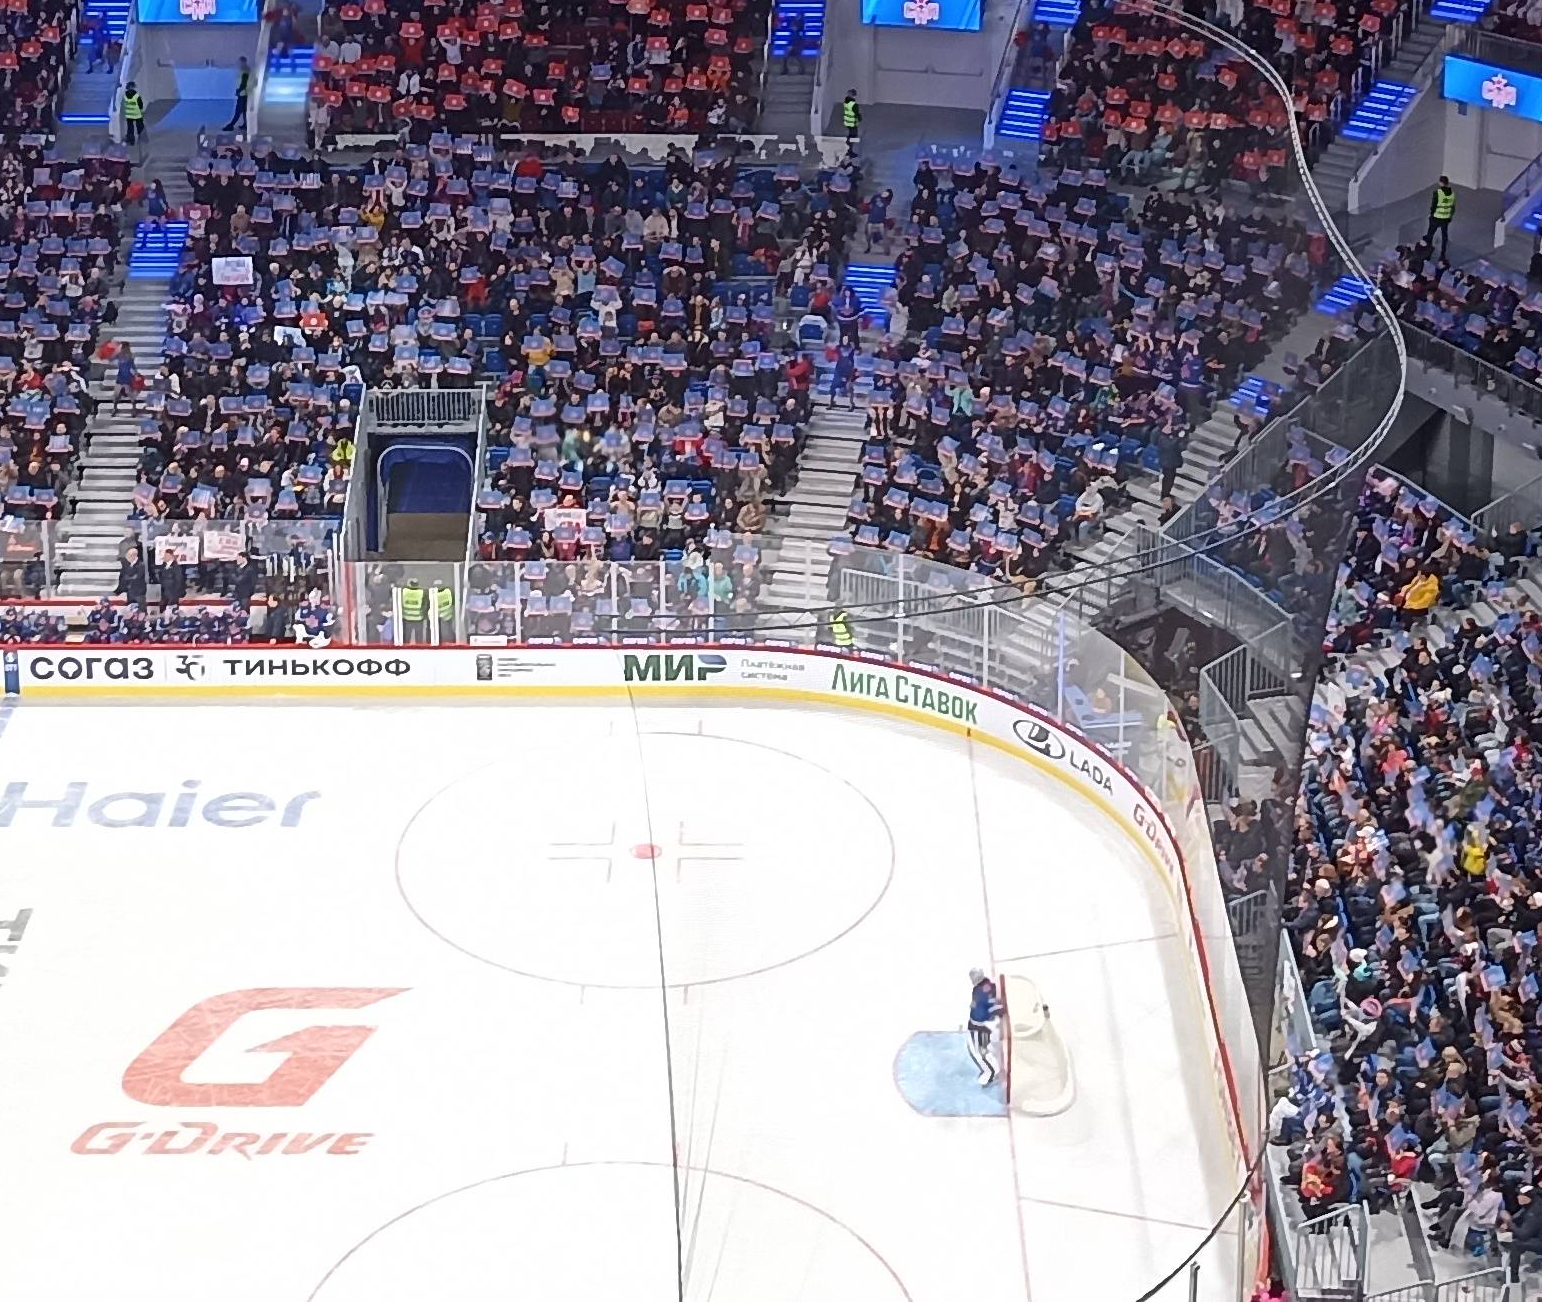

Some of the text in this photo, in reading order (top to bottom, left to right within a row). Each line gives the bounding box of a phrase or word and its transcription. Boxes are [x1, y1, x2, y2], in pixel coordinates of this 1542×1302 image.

[223, 658, 412, 677] ТИНЬКОФФ
[623, 654, 728, 682] МИР
[1069, 749, 1115, 797] LADA
